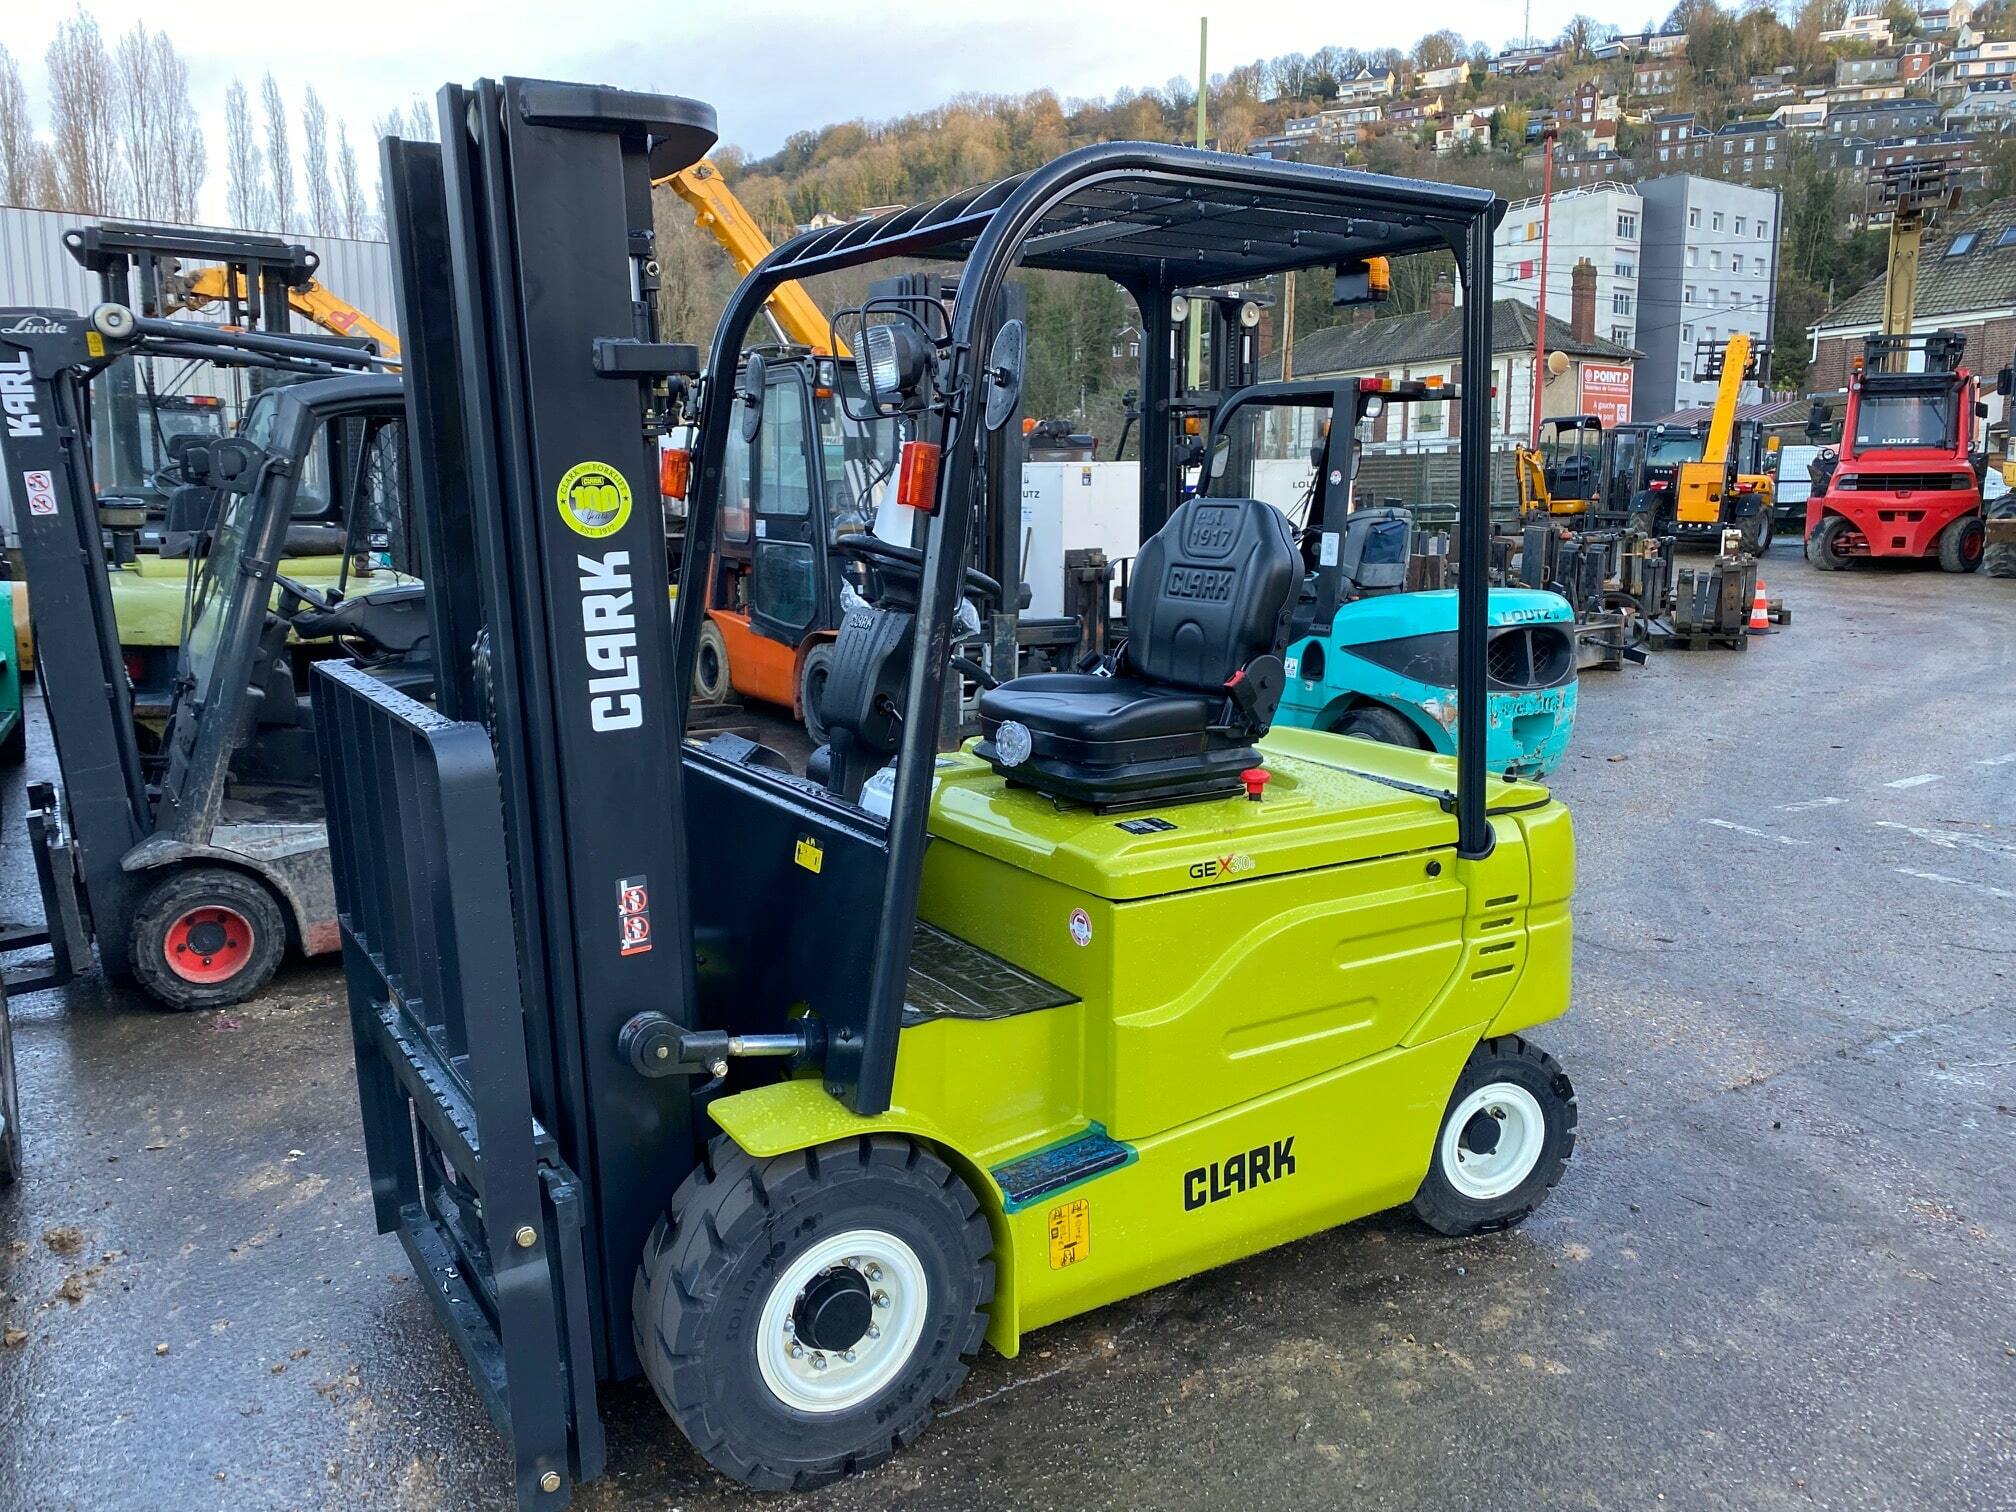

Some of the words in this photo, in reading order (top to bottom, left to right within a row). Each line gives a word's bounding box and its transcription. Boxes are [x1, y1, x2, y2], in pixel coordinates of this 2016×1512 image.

[1, 316, 68, 335] Linde
[0, 351, 43, 437] KARL
[570, 484, 620, 512] 100
[1023, 490, 1041, 499] UTZ
[1192, 528, 1233, 547] 1917
[1168, 570, 1232, 600] CLARK
[1501, 608, 1551, 623] LOUTZ
[577, 550, 643, 732] CLARK
[1184, 1135, 1295, 1212] CLARK
